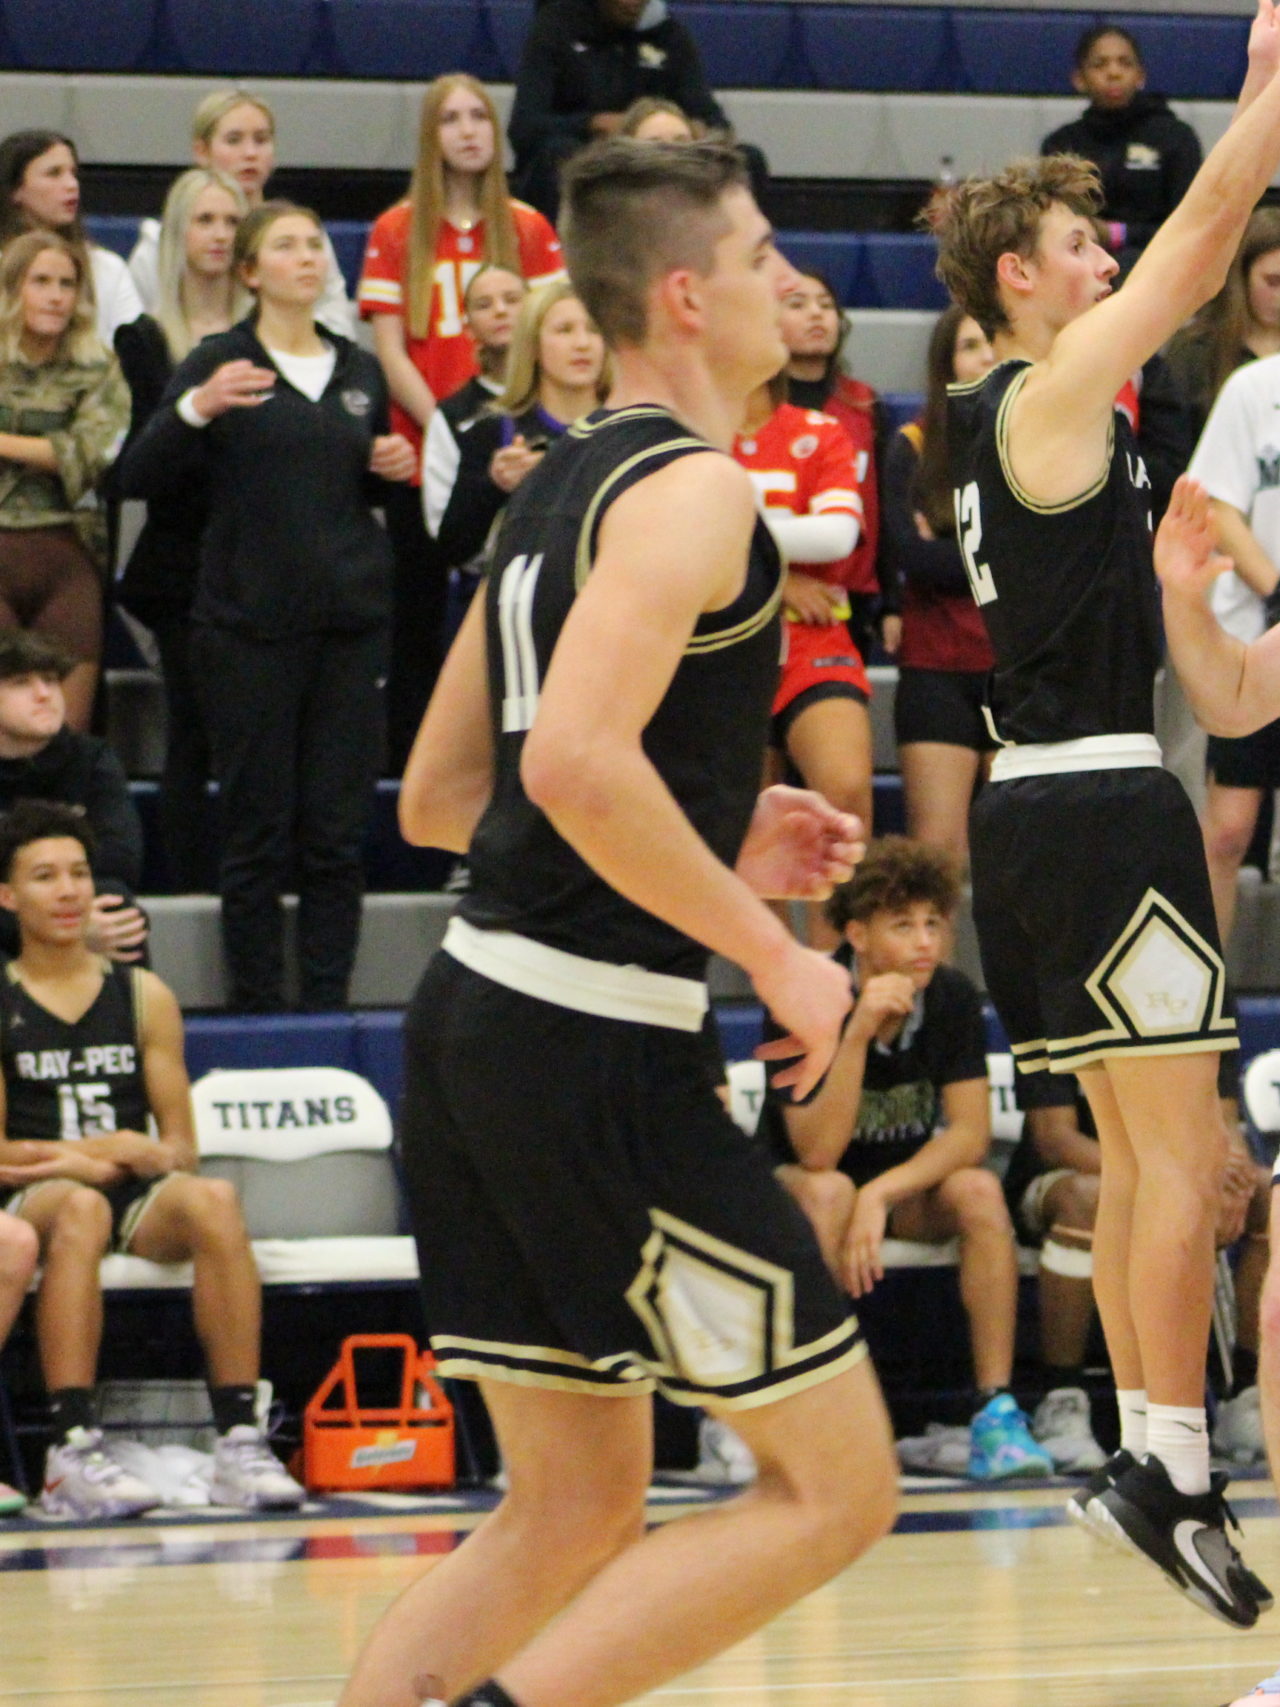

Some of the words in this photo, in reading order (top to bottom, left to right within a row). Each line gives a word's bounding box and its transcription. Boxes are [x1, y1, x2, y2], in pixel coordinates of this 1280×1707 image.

[15, 1044, 136, 1080] RAY-PEC
[58, 1082, 117, 1142] 15
[212, 1095, 358, 1131] TITANS
